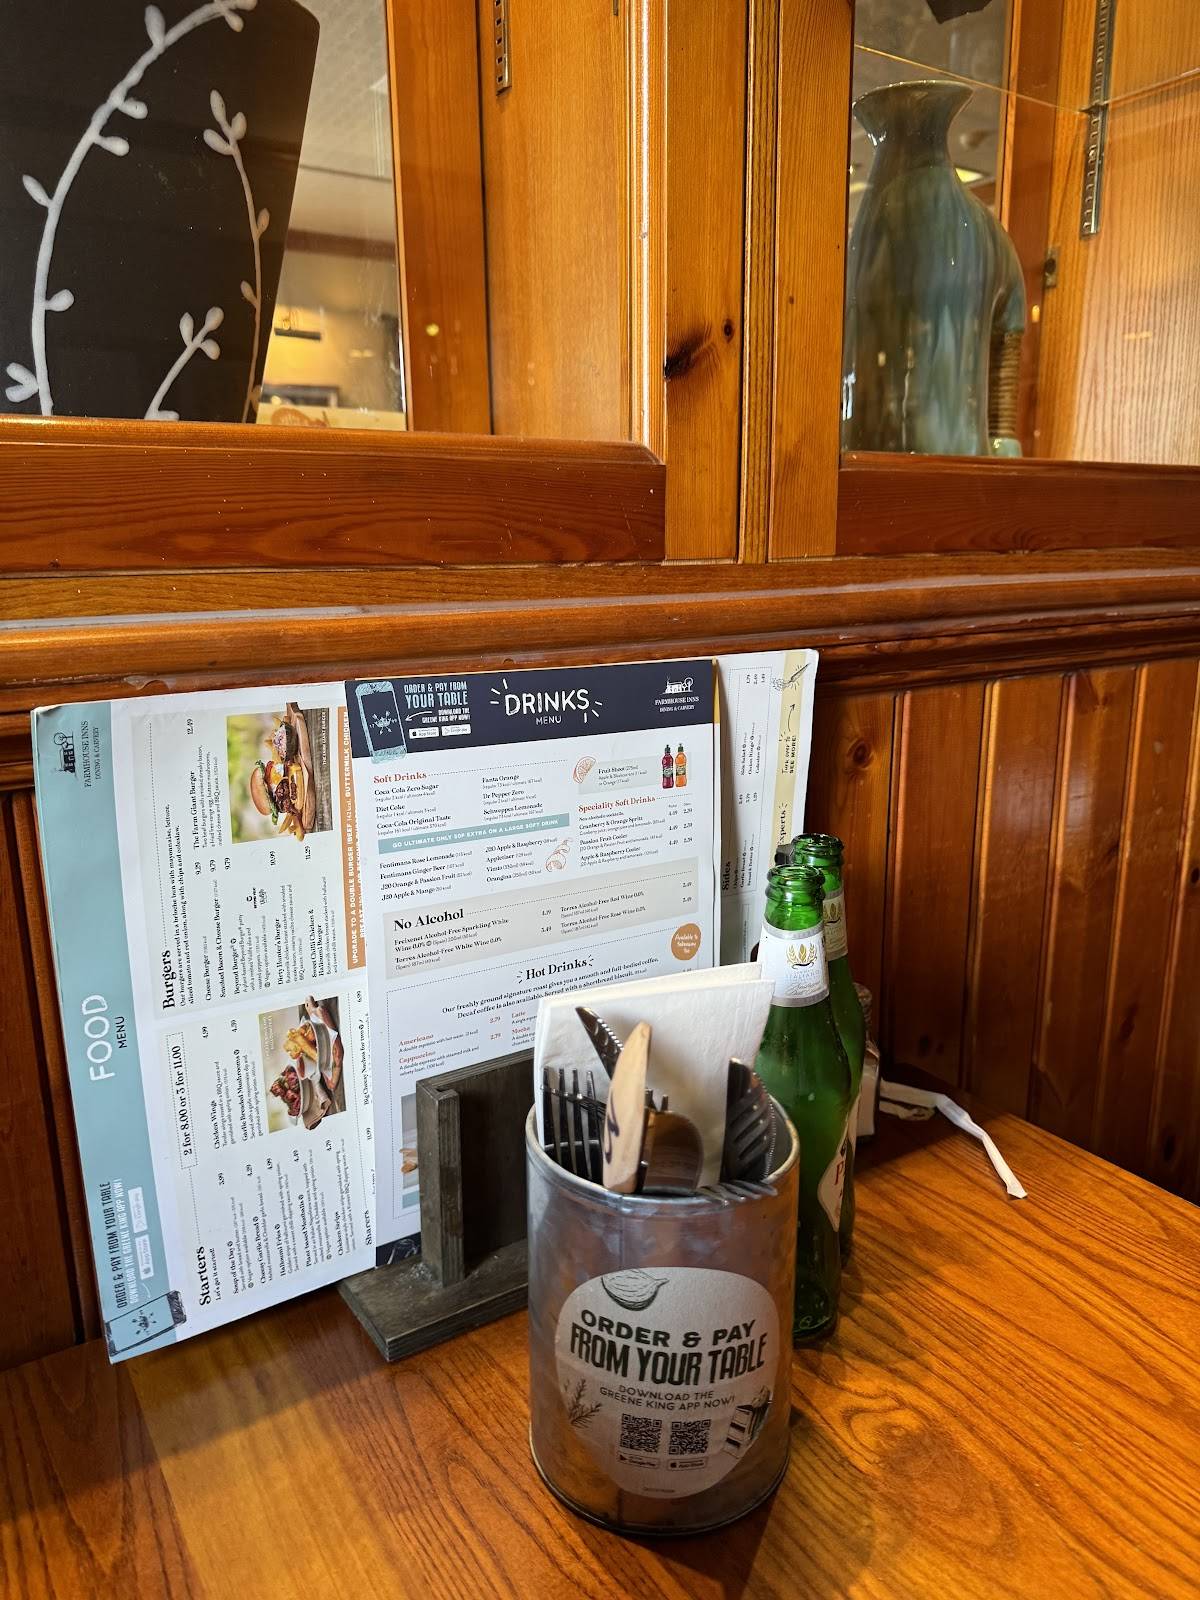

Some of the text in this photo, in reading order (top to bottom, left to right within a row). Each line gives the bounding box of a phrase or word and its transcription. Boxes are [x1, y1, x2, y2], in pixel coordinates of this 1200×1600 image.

[404, 681, 466, 693] ORDER & PAY FROM
[405, 690, 467, 709] YOUR TABLE
[655, 697, 685, 705] FARMHOUSE
[505, 689, 589, 715] DRINKS
[535, 715, 561, 725] MENU
[80, 720, 91, 787] FARMHOUSE INNS
[343, 748, 351, 796] BUTTERMILK
[373, 771, 426, 783] Soft Drinks
[578, 795, 655, 813] Speciality Soft Drinks
[403, 837, 434, 846] ULTIMATE
[467, 829, 486, 837] EXTRA
[504, 823, 523, 831] LARGE
[541, 818, 558, 826] DRINK
[408, 816, 434, 825] Original
[721, 861, 730, 890] Sides
[350, 917, 356, 927] TO
[394, 908, 463, 930] No Alcohol
[162, 950, 176, 1008] Burgers
[526, 959, 587, 980] Hot Drinks
[82, 994, 114, 1080] FOOD
[114, 1015, 127, 1048] MENU
[235, 1055, 243, 1093] Mushrooms
[171, 1045, 192, 1155] 2 for 8.00 or 3 for 11.00
[212, 1121, 220, 1149] Chicken
[364, 1209, 372, 1245] Sharers
[99, 1181, 127, 1308] ORDER & PAY FROM YOUR TABLE
[196, 1246, 210, 1305] Starters
[581, 1310, 756, 1347] ORDER & PAY
[571, 1322, 768, 1386] FROM YOUR TABLE
[600, 1387, 735, 1410] GREENE KING APP NOW!
[619, 1385, 714, 1400] DOWNLOAD THE
